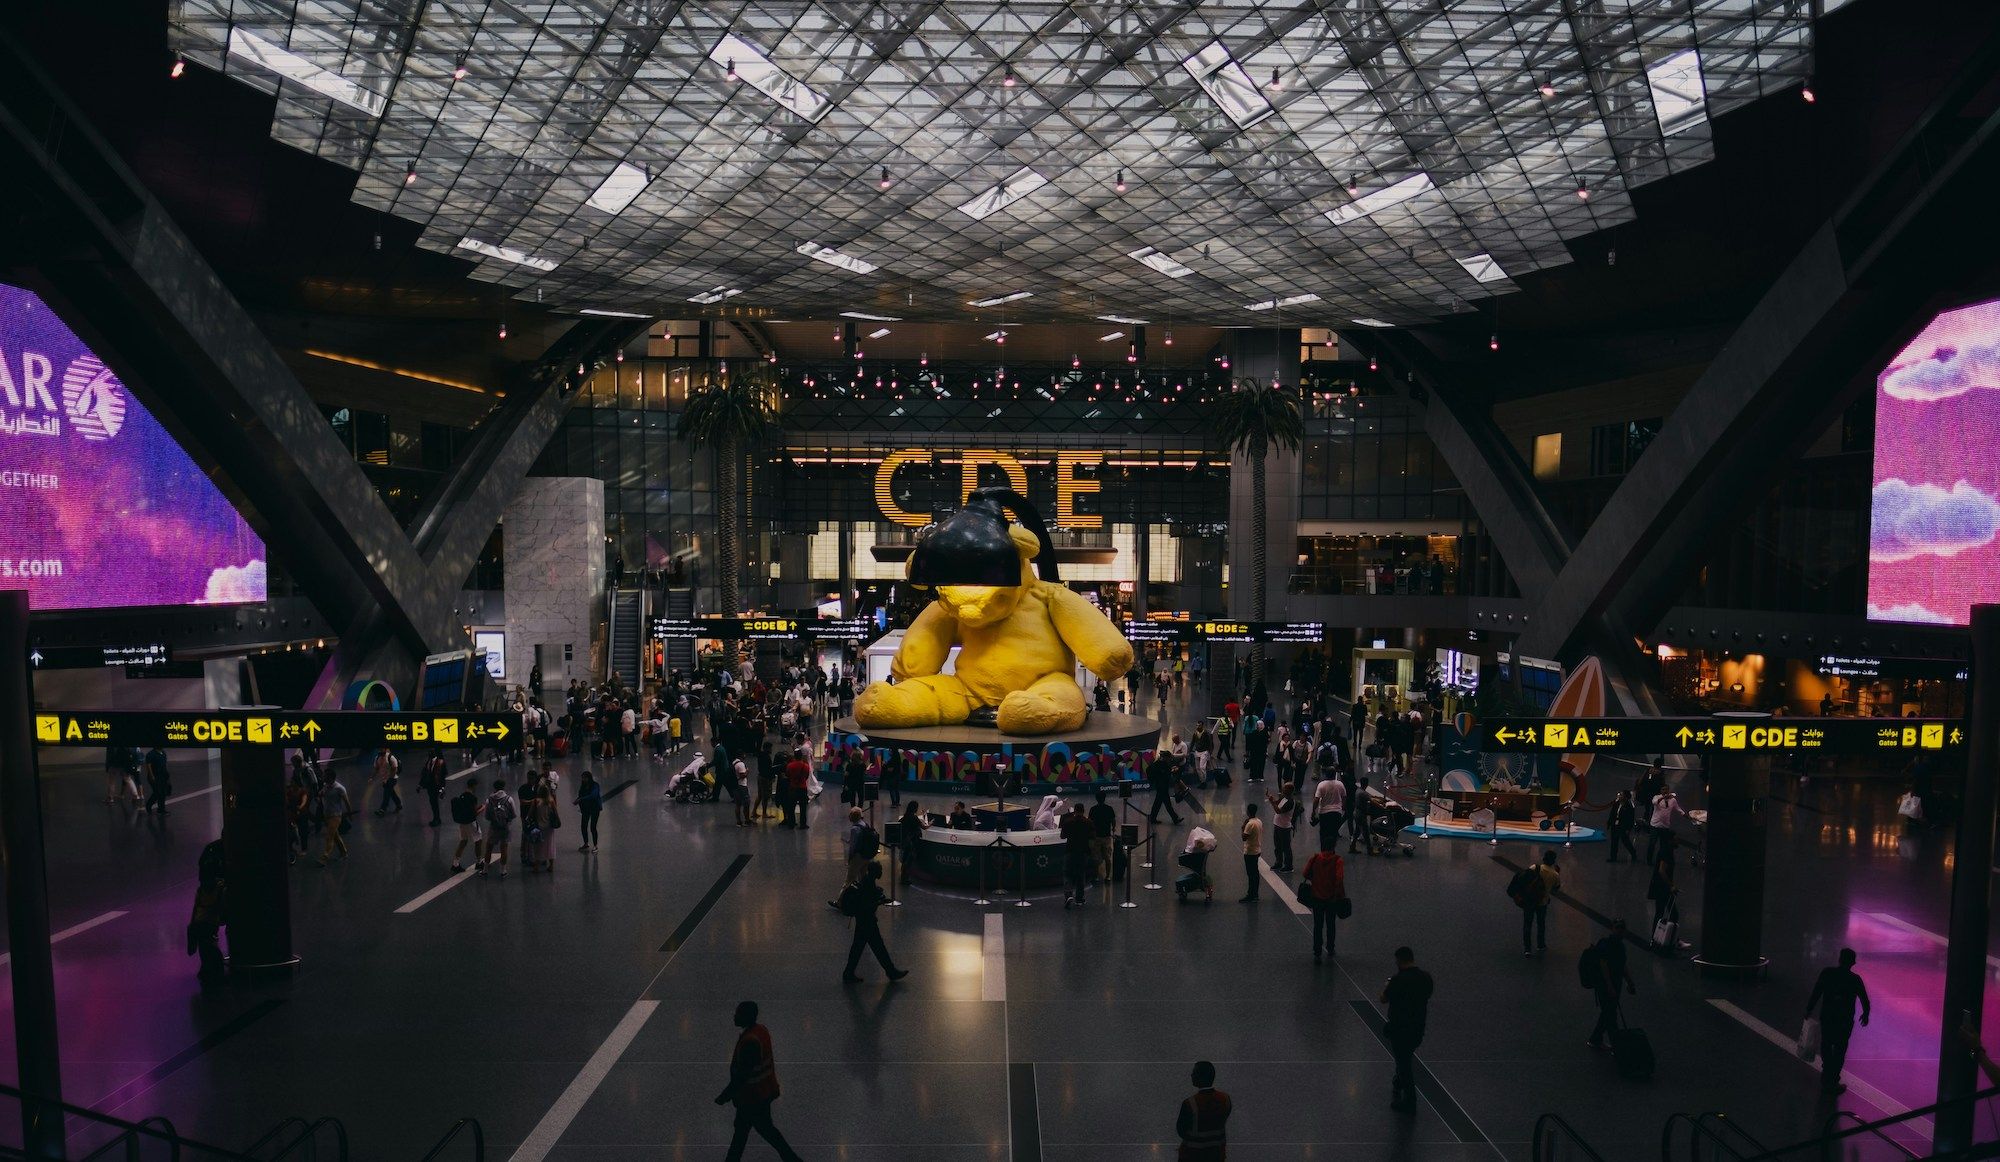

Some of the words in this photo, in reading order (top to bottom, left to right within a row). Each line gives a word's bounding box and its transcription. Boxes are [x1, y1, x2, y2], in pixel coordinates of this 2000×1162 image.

[0, 472, 58, 489] GETHER
[874, 448, 1104, 528] CDE
[754, 621, 776, 630] CDE
[1216, 624, 1238, 633] CDE
[66, 720, 83, 739] A
[88, 731, 109, 739] Gates
[193, 721, 243, 741] CDE
[412, 721, 429, 741] B
[167, 732, 189, 741] Gates
[386, 733, 408, 741] Gates
[1572, 727, 1591, 746] A
[1595, 738, 1616, 746] Gates
[1751, 727, 1798, 747] CDE
[1801, 739, 1822, 747] Gates
[1878, 739, 1898, 747] Gates
[1901, 727, 1917, 746] B
